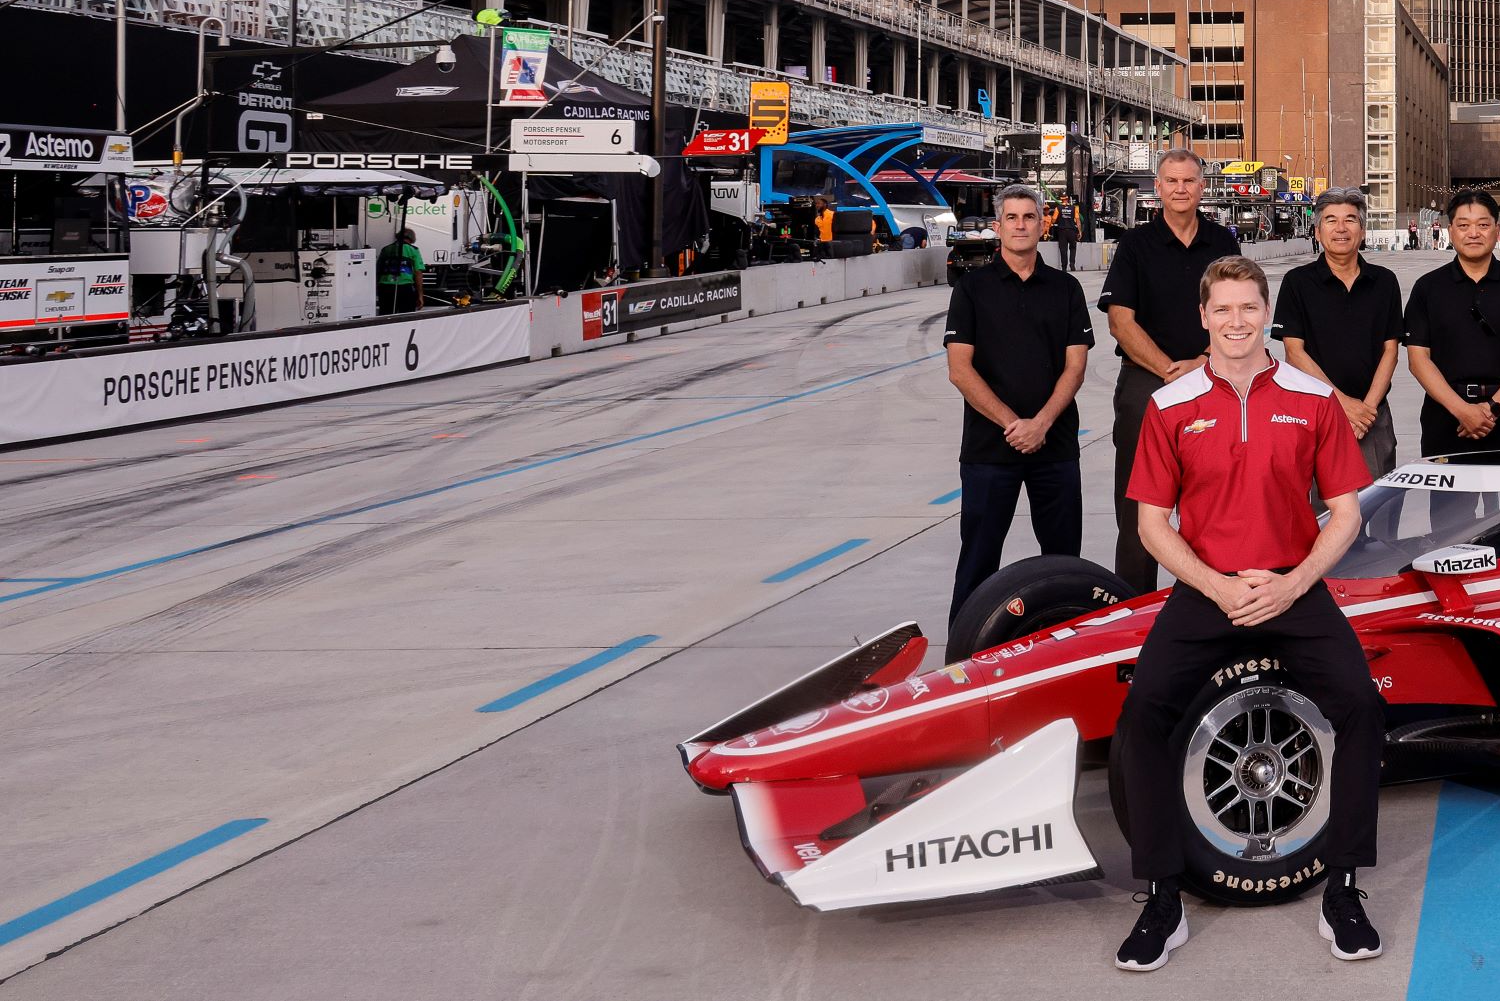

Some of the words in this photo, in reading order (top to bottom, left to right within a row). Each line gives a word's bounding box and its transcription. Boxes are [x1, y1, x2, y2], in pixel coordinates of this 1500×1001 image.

[238, 91, 293, 110] DETROIT
[563, 105, 615, 120] CADILLAC
[617, 108, 650, 121] RACING
[237, 109, 293, 153] GP
[610, 128, 622, 145] 6
[25, 130, 94, 158] Astemo
[728, 131, 750, 152] 31
[1043, 135, 1065, 153] 7
[286, 153, 473, 170] PORSCHE
[1244, 163, 1256, 172] 01
[1248, 185, 1261, 194] 40
[1290, 180, 1303, 189] 26
[1293, 193, 1303, 201] 10
[137, 202, 167, 217] Racing
[0, 278, 29, 289] TEAM
[96, 274, 122, 284] TEAM
[0, 290, 32, 301] ENSKE
[88, 285, 125, 296] PENSKE
[660, 291, 705, 310] CADILLAC
[706, 286, 739, 302] RACING
[45, 305, 76, 313] CHEVROLET
[603, 300, 618, 327] 31
[103, 365, 201, 407] PORSCHE
[206, 355, 278, 391] PENSKE
[282, 342, 390, 382] MOTORSPORT
[404, 328, 420, 372] 6
[1270, 413, 1308, 426] Astemo
[1381, 470, 1456, 489] ARDEN
[1433, 552, 1497, 574] Mazak
[1211, 657, 1281, 688] Fires
[885, 822, 1054, 873] HITACHI
[1212, 857, 1326, 894] Firestone
